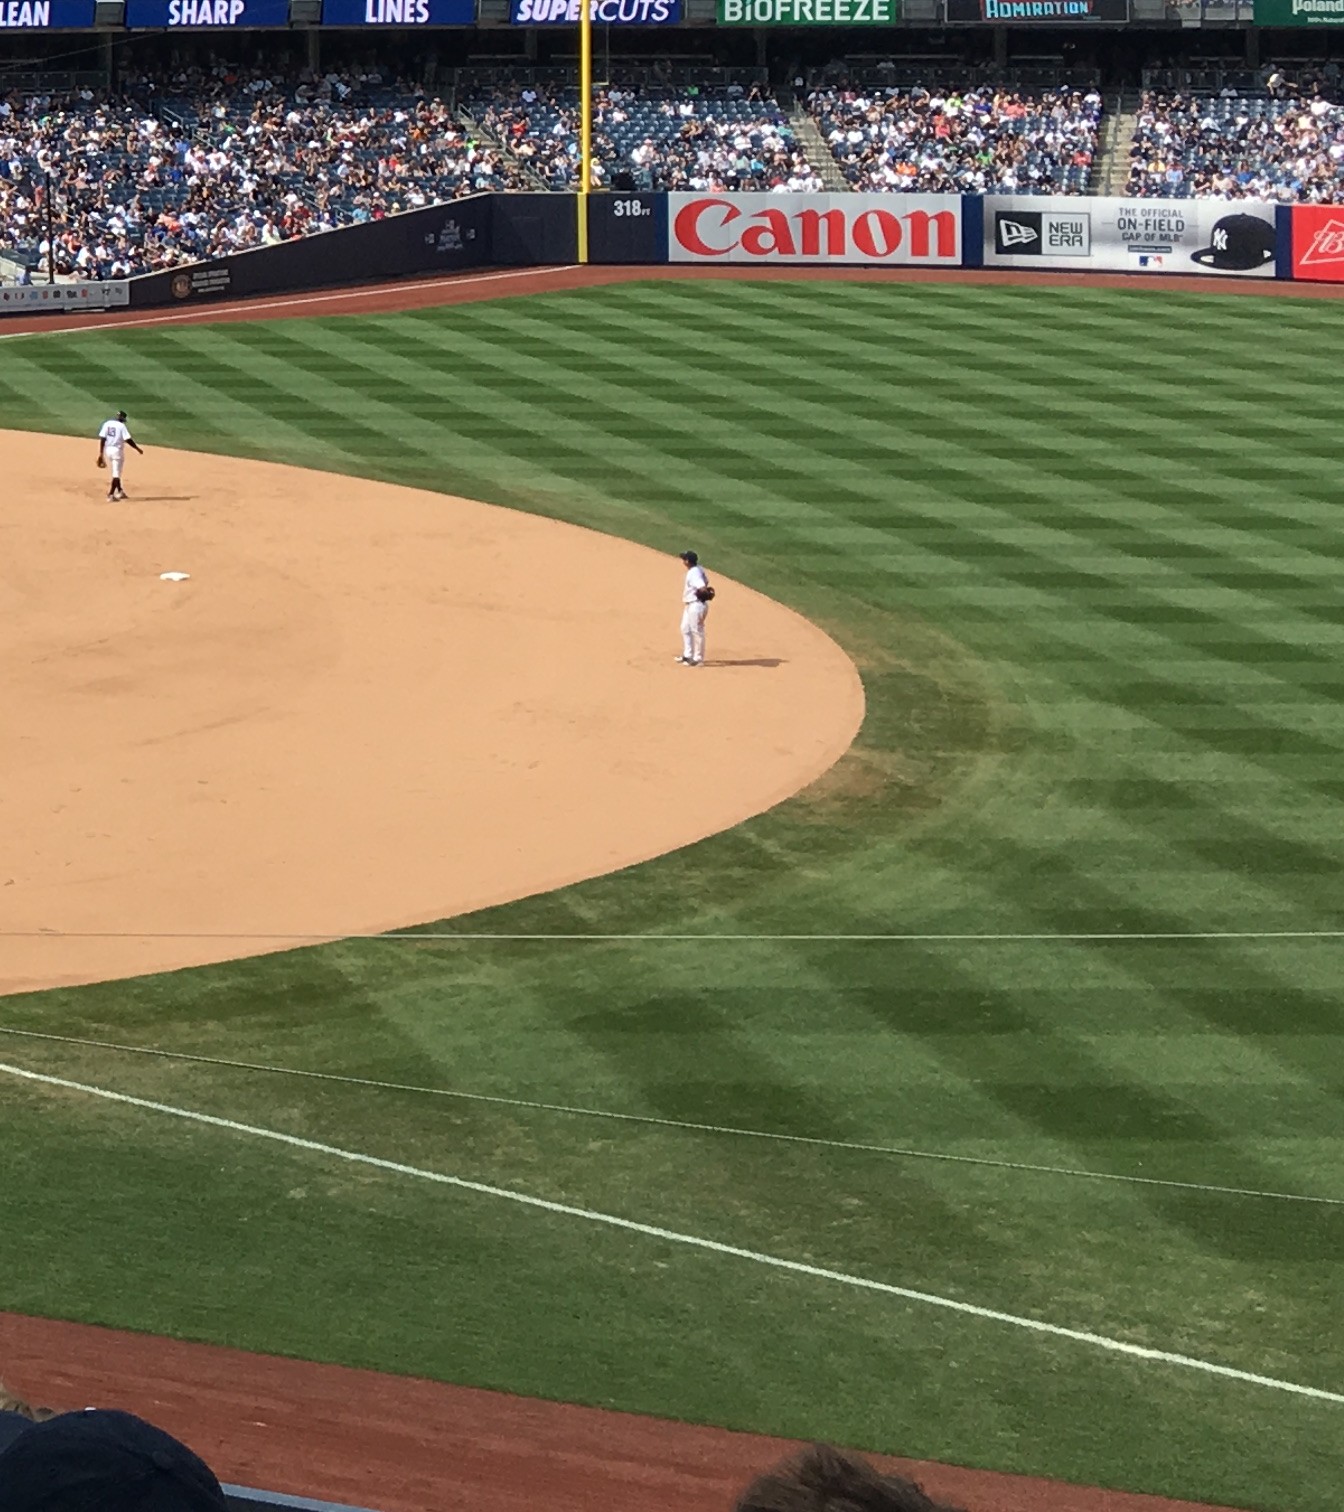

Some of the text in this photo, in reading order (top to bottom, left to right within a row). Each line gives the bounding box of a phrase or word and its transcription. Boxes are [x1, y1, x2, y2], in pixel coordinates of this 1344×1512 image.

[168, 0, 245, 25] SHARP
[1119, 207, 1184, 218] THE OFFICIAL
[674, 198, 956, 258] Canon
[1048, 221, 1083, 235] NEW
[1117, 218, 1184, 232] ON-FIELD
[1049, 235, 1083, 247] ERA
[1122, 232, 1142, 241] CAP
[1144, 232, 1157, 242] OF
